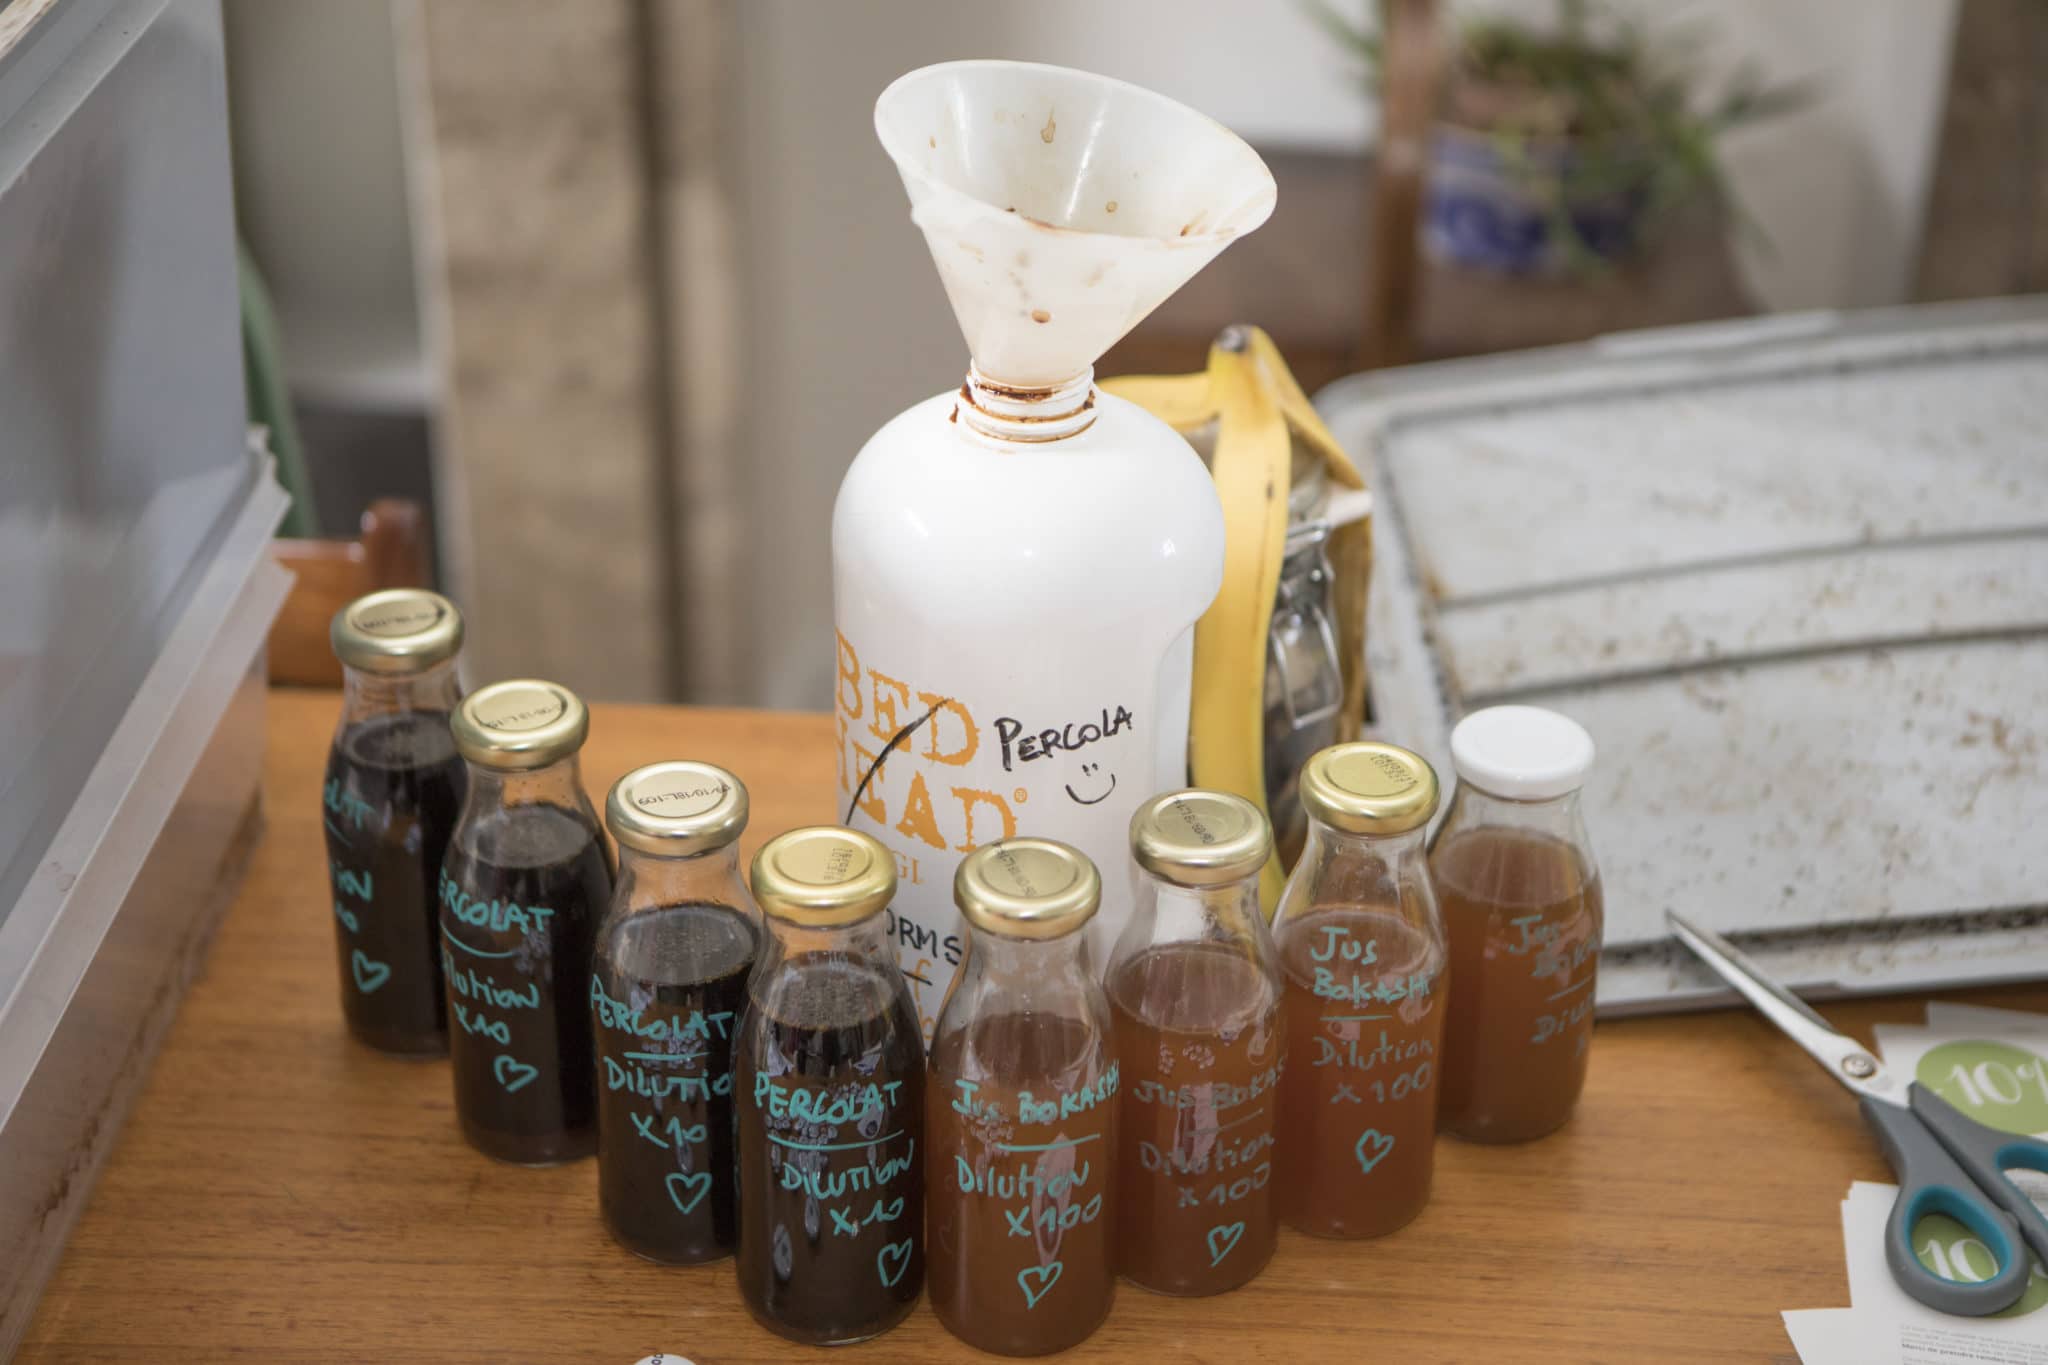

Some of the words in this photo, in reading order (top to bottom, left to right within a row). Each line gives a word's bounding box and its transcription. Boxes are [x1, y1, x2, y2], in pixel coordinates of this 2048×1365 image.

[836, 628, 980, 767] BED
[994, 705, 1132, 772] PERCOLA
[1311, 926, 1377, 965] Jus
[754, 1071, 903, 1126] PERCOLAT
